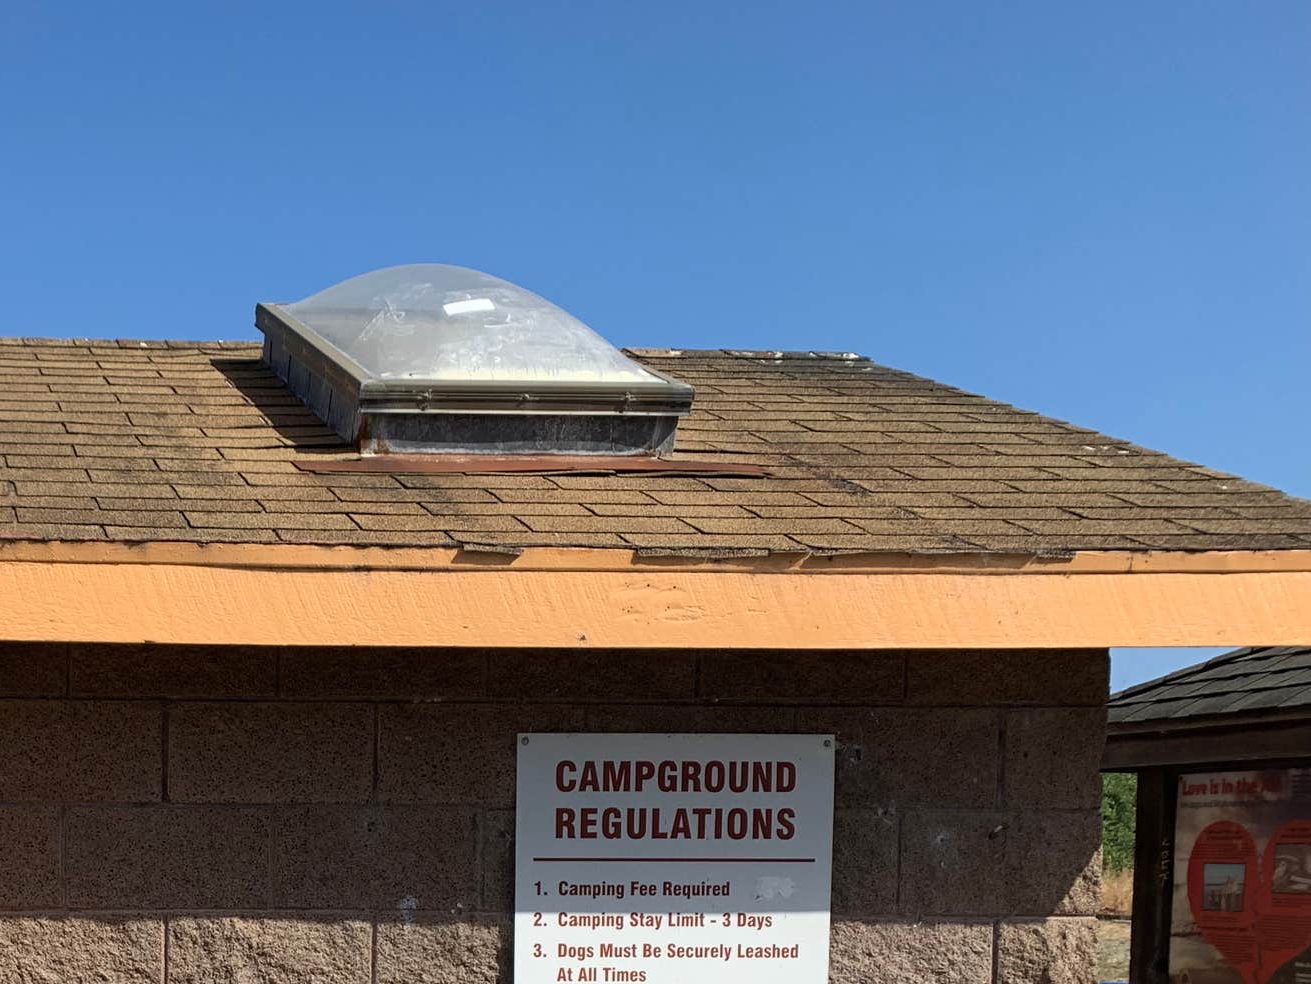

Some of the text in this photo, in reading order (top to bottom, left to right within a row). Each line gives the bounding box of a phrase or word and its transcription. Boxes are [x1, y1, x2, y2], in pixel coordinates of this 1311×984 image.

[555, 759, 796, 793] CAMPGROUND
[555, 806, 795, 840] REGULATIONS
[534, 880, 730, 899] 1. Camping Fee Required
[533, 912, 547, 926] 2.
[558, 911, 623, 930] Camping
[629, 911, 662, 930] Stay
[668, 912, 705, 927] Limit
[722, 912, 731, 927] 3
[737, 912, 772, 930] Days
[533, 943, 798, 961] 3. Dogs Must Be Securely Leashed
[556, 967, 646, 982] At All Times
